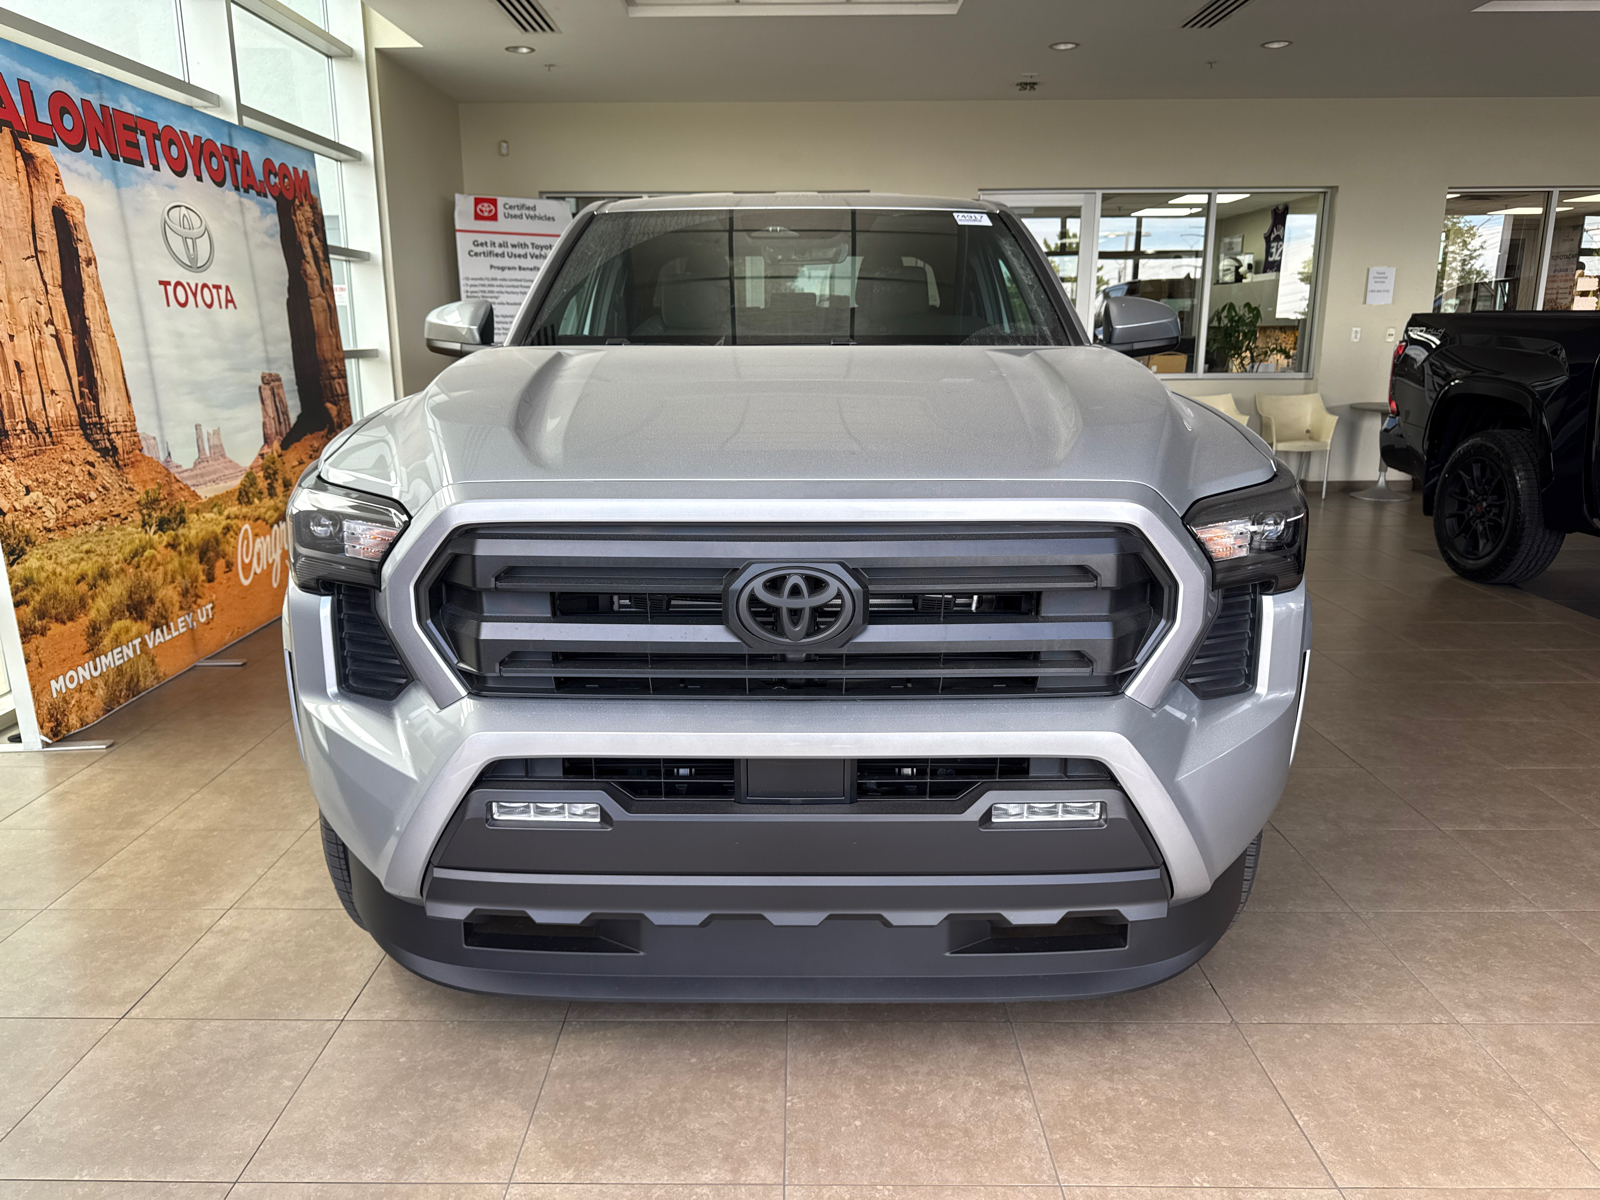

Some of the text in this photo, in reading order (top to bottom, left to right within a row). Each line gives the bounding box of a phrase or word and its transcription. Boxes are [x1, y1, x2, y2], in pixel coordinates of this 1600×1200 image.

[503, 203, 537, 212] Certified
[503, 212, 556, 222] Used Vehicles
[472, 240, 487, 248] Get
[510, 242, 529, 250] with
[530, 243, 554, 252] Toyot
[468, 249, 548, 260] Certified Used Vehi
[489, 264, 517, 273] Program
[158, 279, 238, 310] TOYOTA
[238, 521, 288, 588] Congr
[49, 602, 214, 699] MONUMENT VALLEY, UT
